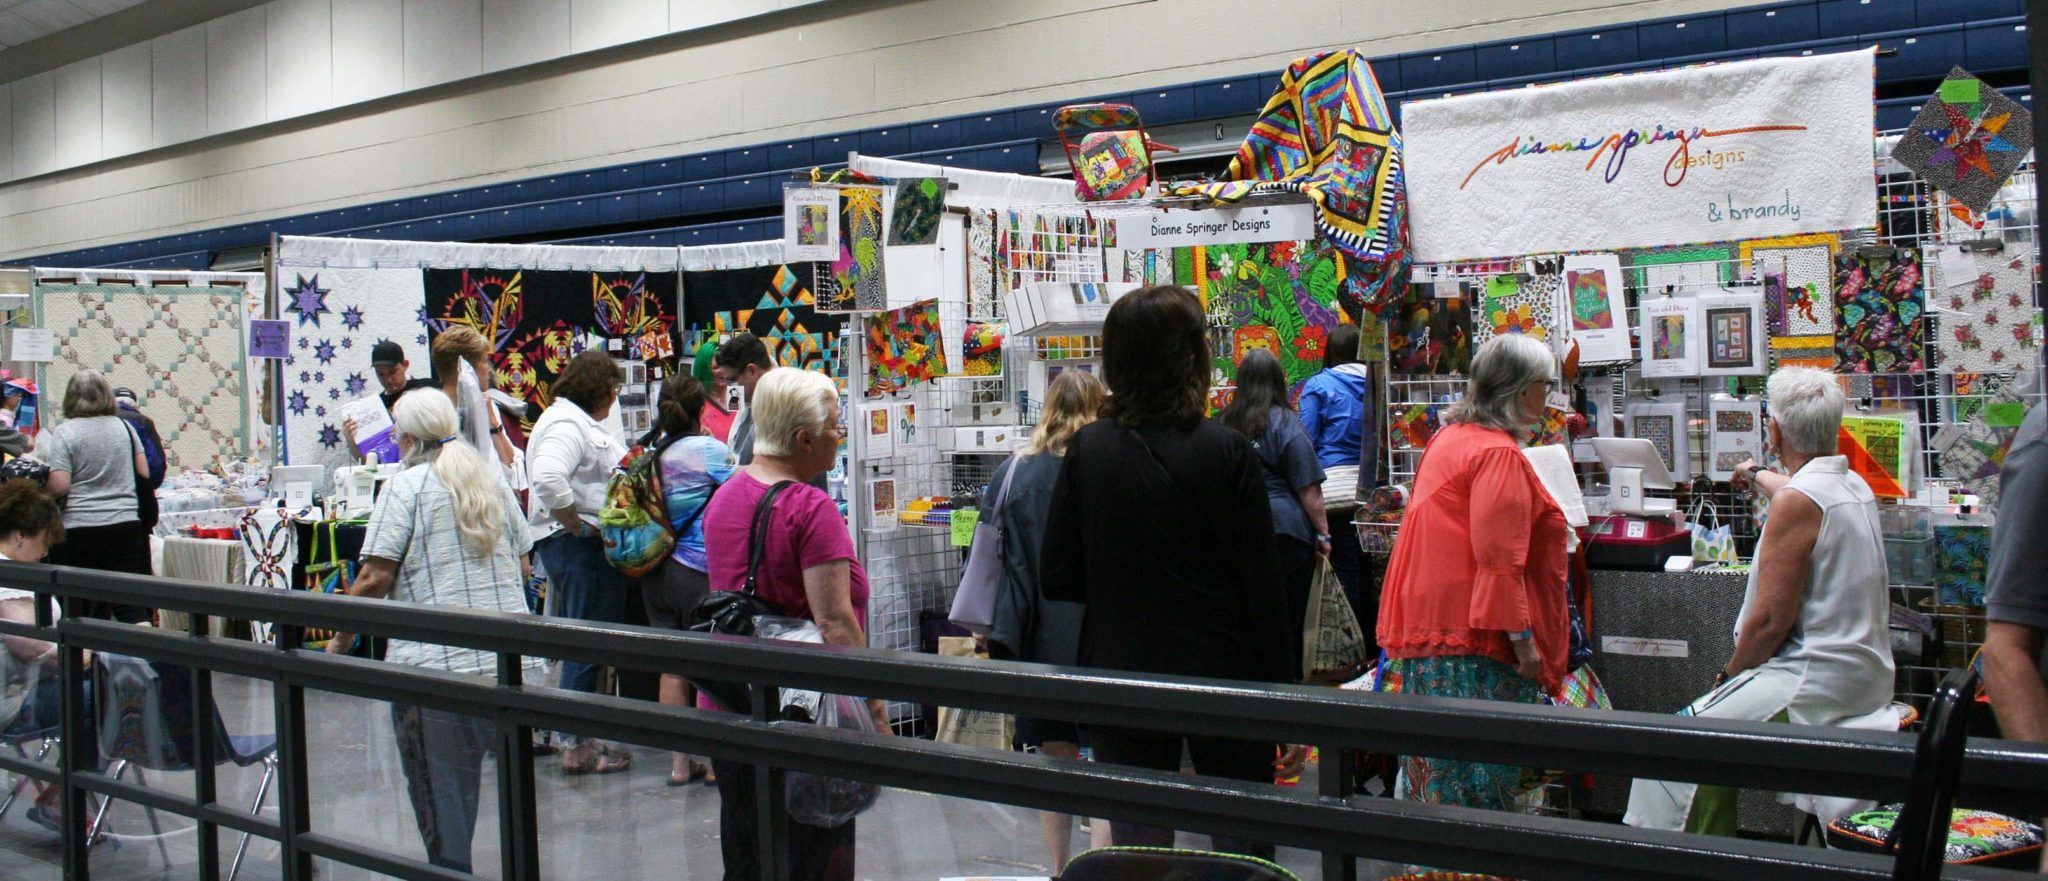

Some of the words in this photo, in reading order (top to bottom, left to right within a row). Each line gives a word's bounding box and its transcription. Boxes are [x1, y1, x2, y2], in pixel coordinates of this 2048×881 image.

[1216, 124, 1223, 139] K
[1460, 136, 1603, 190] dianne
[1586, 125, 1807, 187] springer
[1674, 149, 1745, 169] designs
[1708, 203, 1723, 221] &
[1728, 189, 1801, 221] brandy
[1151, 225, 1181, 236] Dianne
[1186, 222, 1227, 236] Springer
[1232, 219, 1271, 233] Designs
